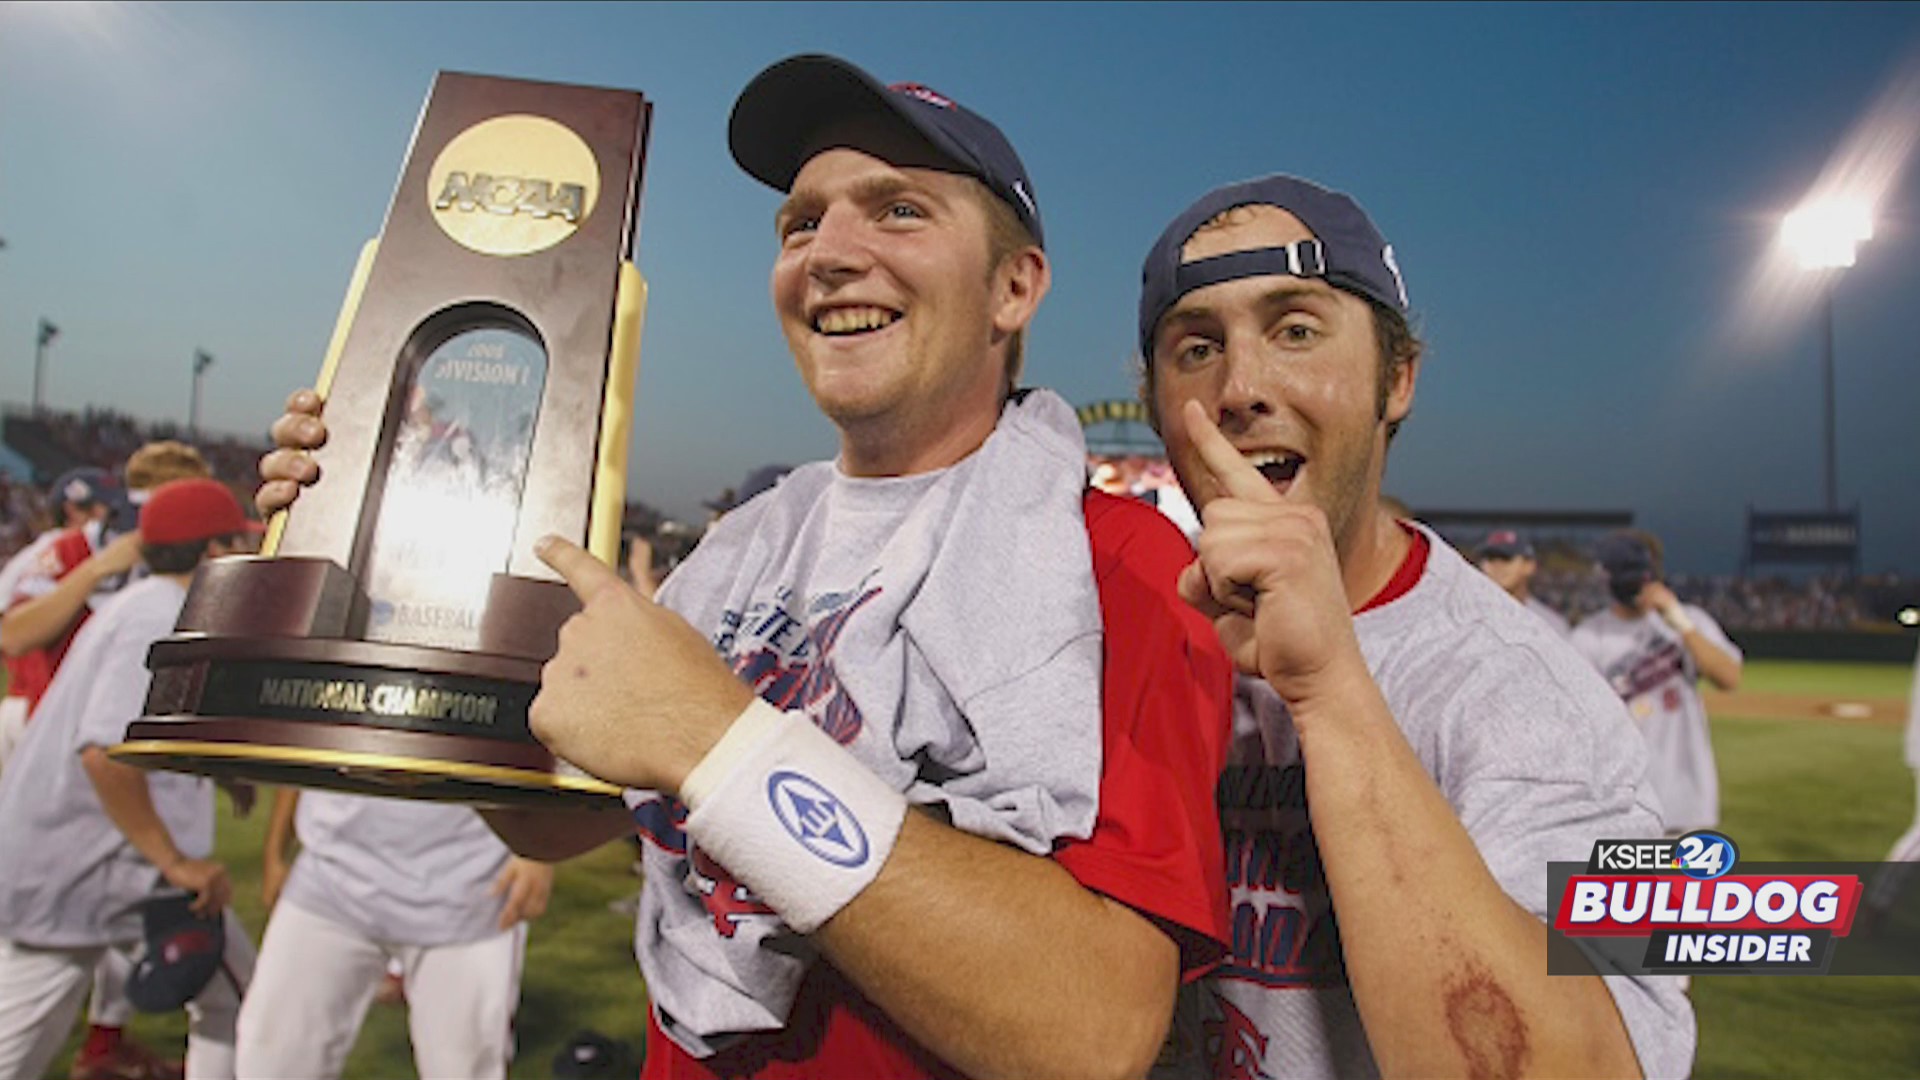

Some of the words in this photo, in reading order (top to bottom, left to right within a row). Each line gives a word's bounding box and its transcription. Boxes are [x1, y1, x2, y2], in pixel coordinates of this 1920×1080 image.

[436, 171, 585, 224] NCAA
[397, 602, 477, 631] BASEBAL
[259, 678, 368, 713] NATIONAL
[369, 684, 498, 725] CHAMPION
